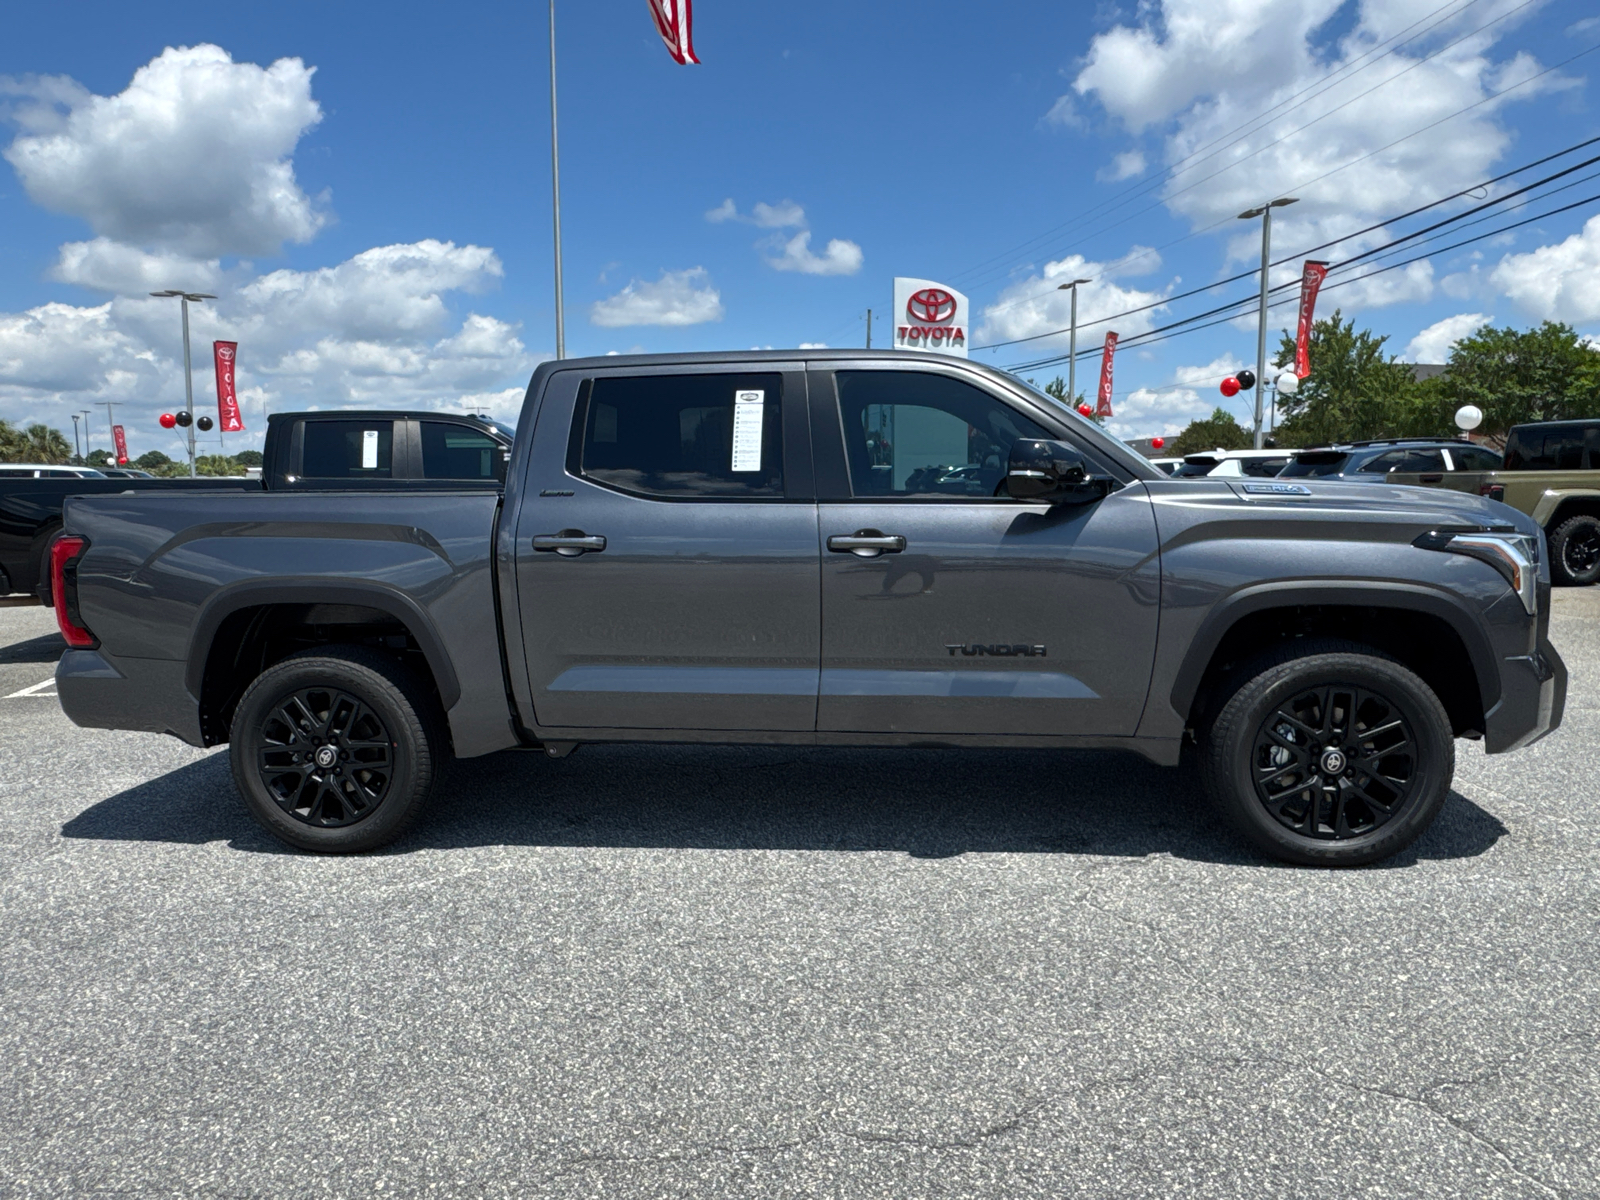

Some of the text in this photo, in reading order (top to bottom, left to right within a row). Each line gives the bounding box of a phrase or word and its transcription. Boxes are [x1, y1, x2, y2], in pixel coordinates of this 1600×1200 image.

[898, 326, 965, 340] TOYOTA
[223, 361, 240, 428] TOYOTA
[944, 644, 1047, 657] TUNDRA
